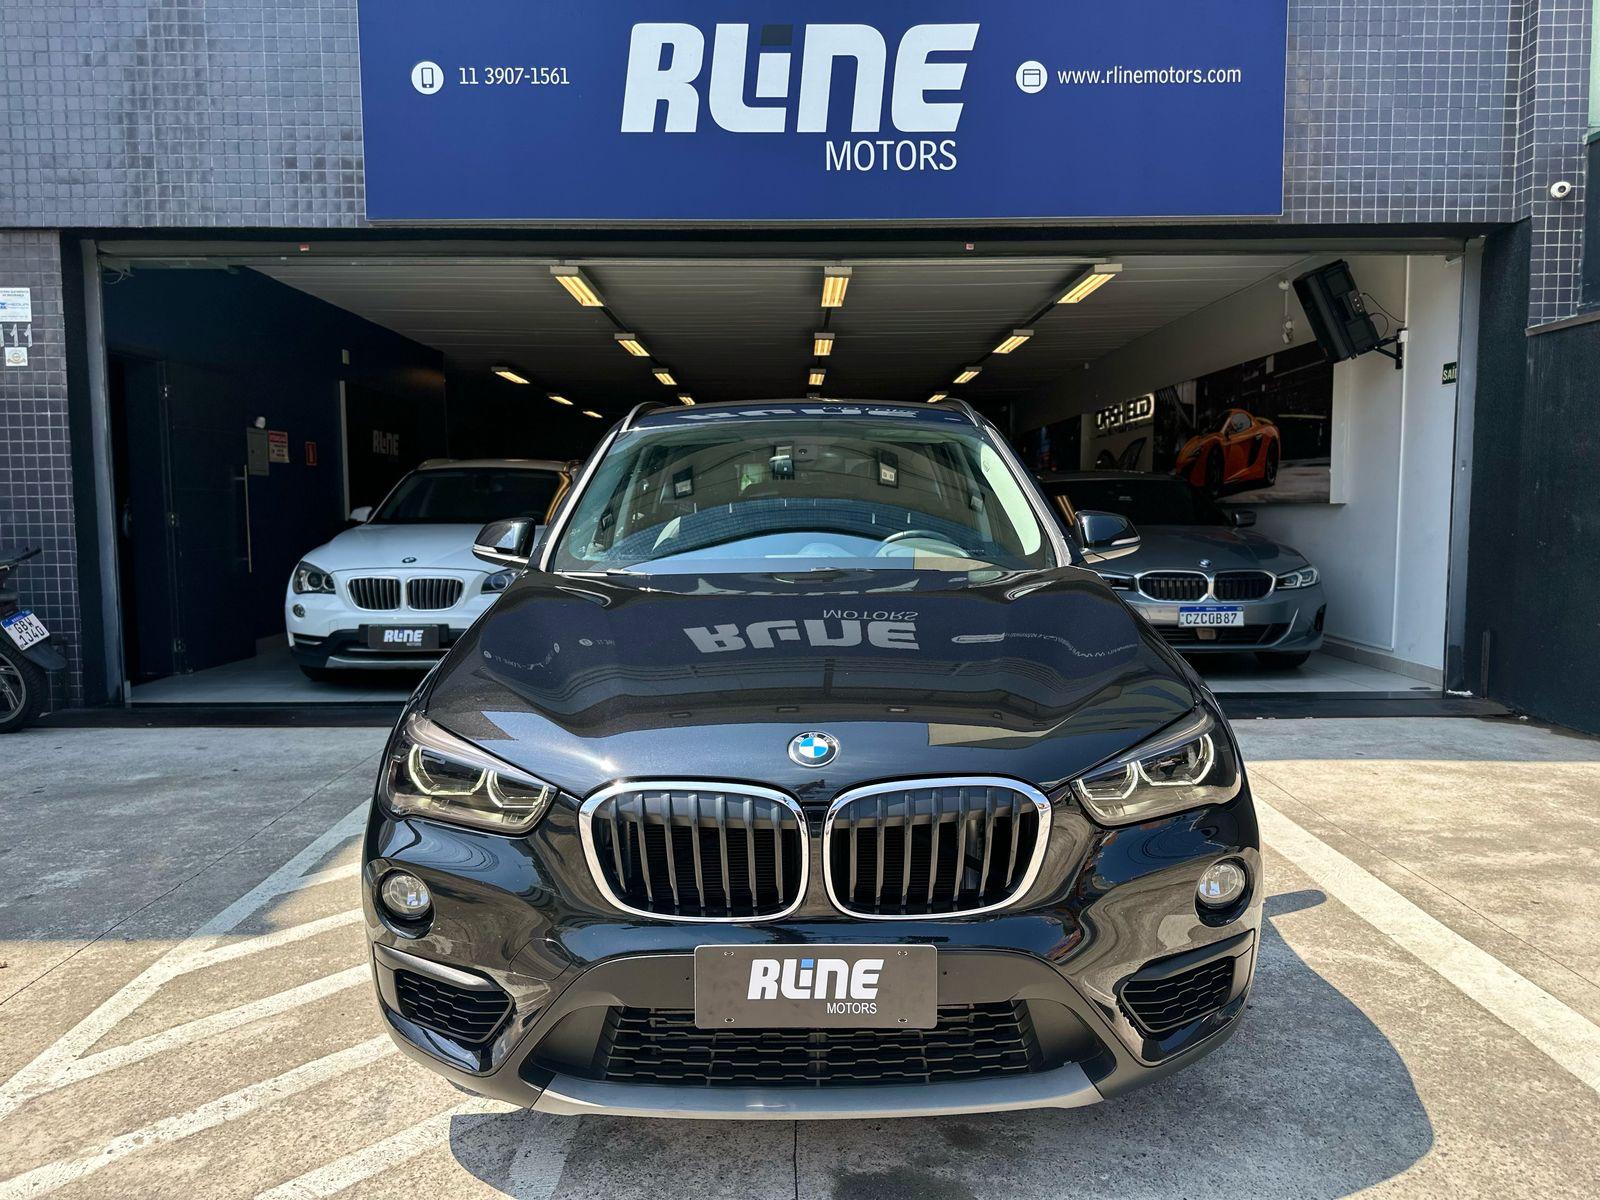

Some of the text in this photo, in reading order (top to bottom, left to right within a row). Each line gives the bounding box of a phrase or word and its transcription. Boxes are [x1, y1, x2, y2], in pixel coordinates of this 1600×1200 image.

[459, 67, 570, 85] 11 3907-1561
[1057, 66, 1242, 84] www.rlinemotors.com
[825, 140, 958, 171] MOTORS
[746, 957, 885, 1000] RLINE
[826, 1002, 878, 1014] MOTORS
